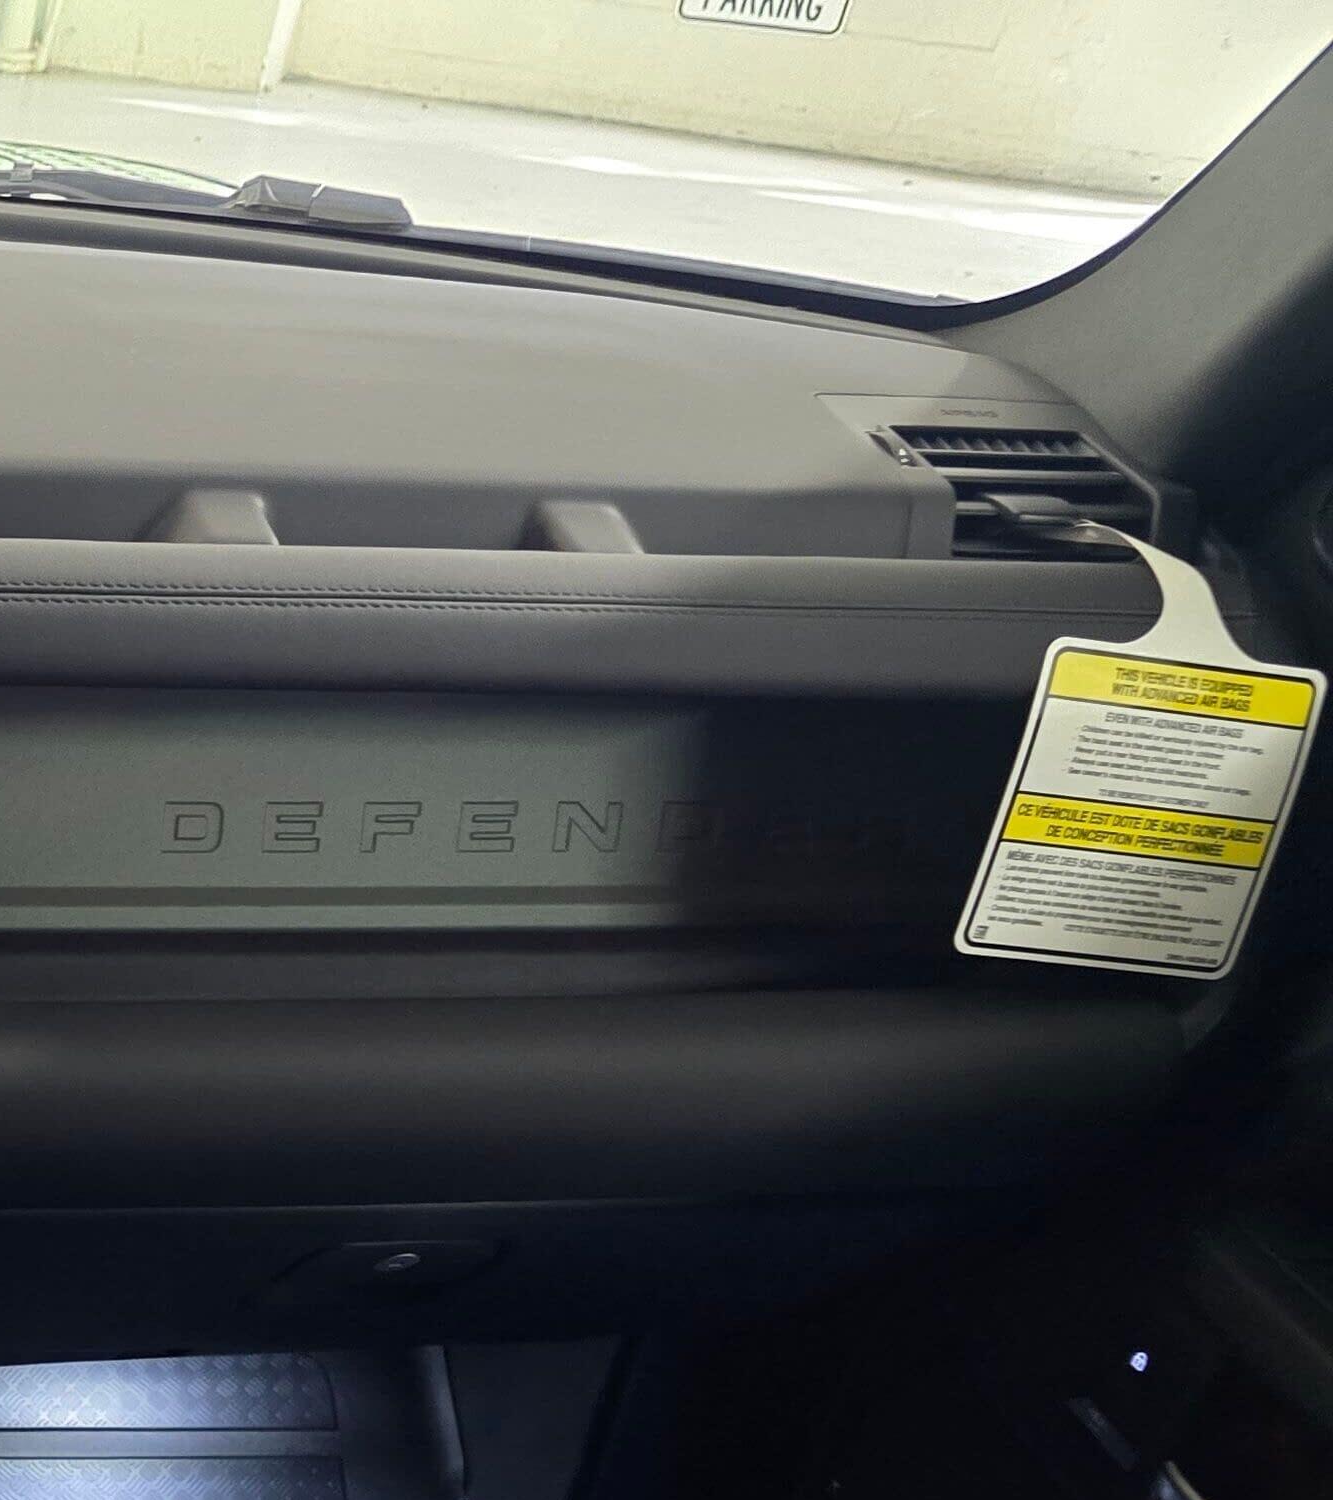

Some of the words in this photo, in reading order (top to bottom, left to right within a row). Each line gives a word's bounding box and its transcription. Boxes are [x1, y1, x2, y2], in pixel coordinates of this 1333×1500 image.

[1116, 667, 1141, 682] THIS
[1141, 670, 1186, 688] VEHICLE
[1112, 683, 1139, 698] WITH
[161, 800, 723, 854] DEFEN
[1017, 803, 1033, 816] CE
[1089, 811, 1112, 825] EST
[1142, 818, 1159, 831] DE
[1046, 824, 1063, 837] DE
[1063, 827, 1133, 846] CONCEPTION
